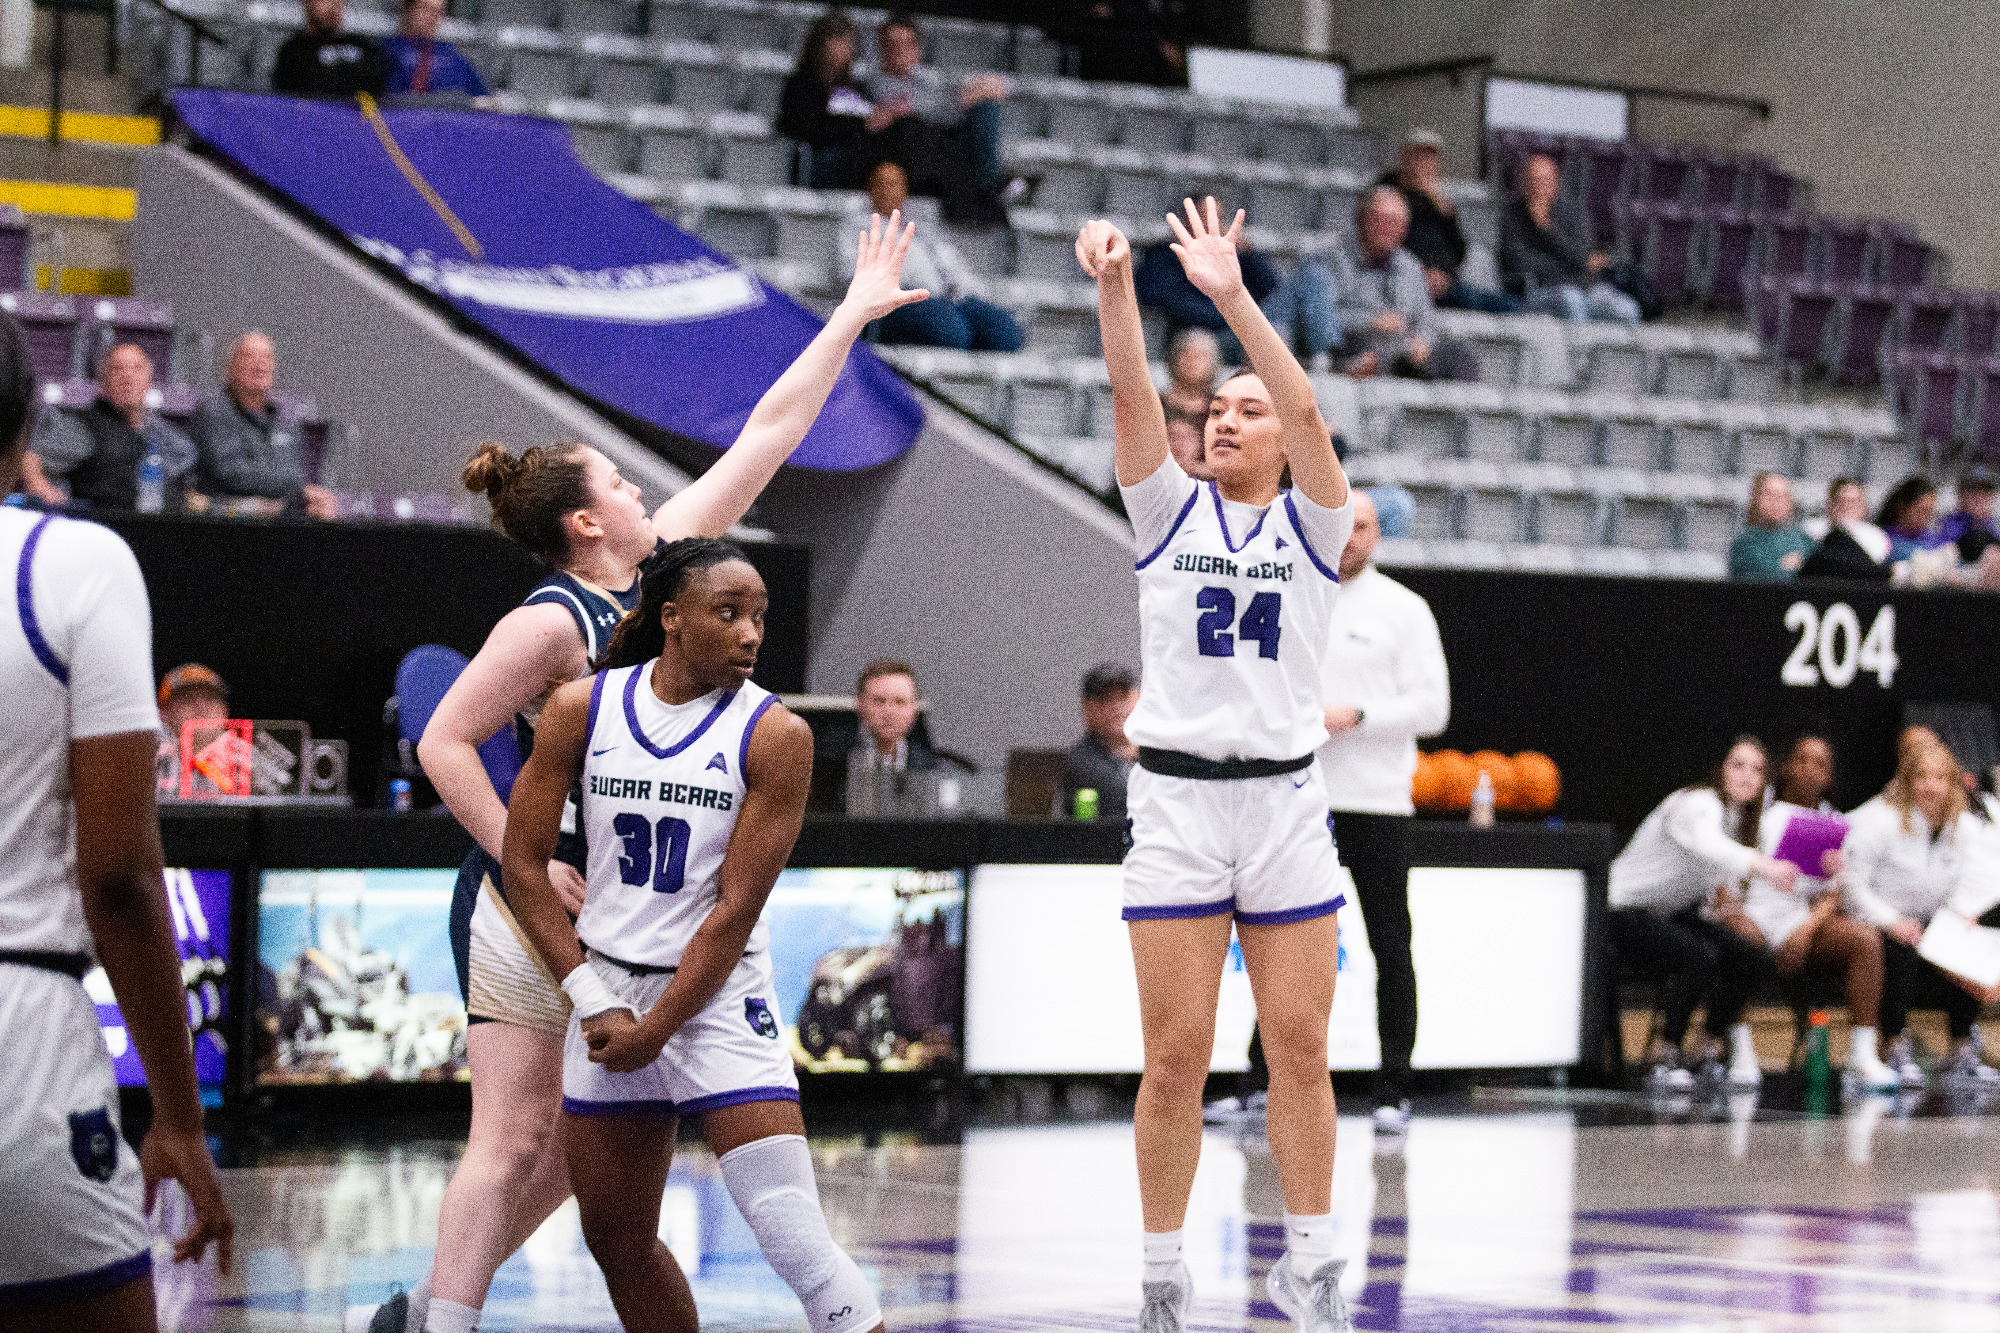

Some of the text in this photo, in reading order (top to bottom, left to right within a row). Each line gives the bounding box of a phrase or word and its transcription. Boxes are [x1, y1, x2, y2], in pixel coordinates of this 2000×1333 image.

[1173, 554, 1238, 577] SUGAR
[1196, 586, 1282, 661] 24
[1781, 601, 1900, 688] 204
[590, 776, 733, 811] SUGAR BEARS
[613, 813, 692, 893] 30
